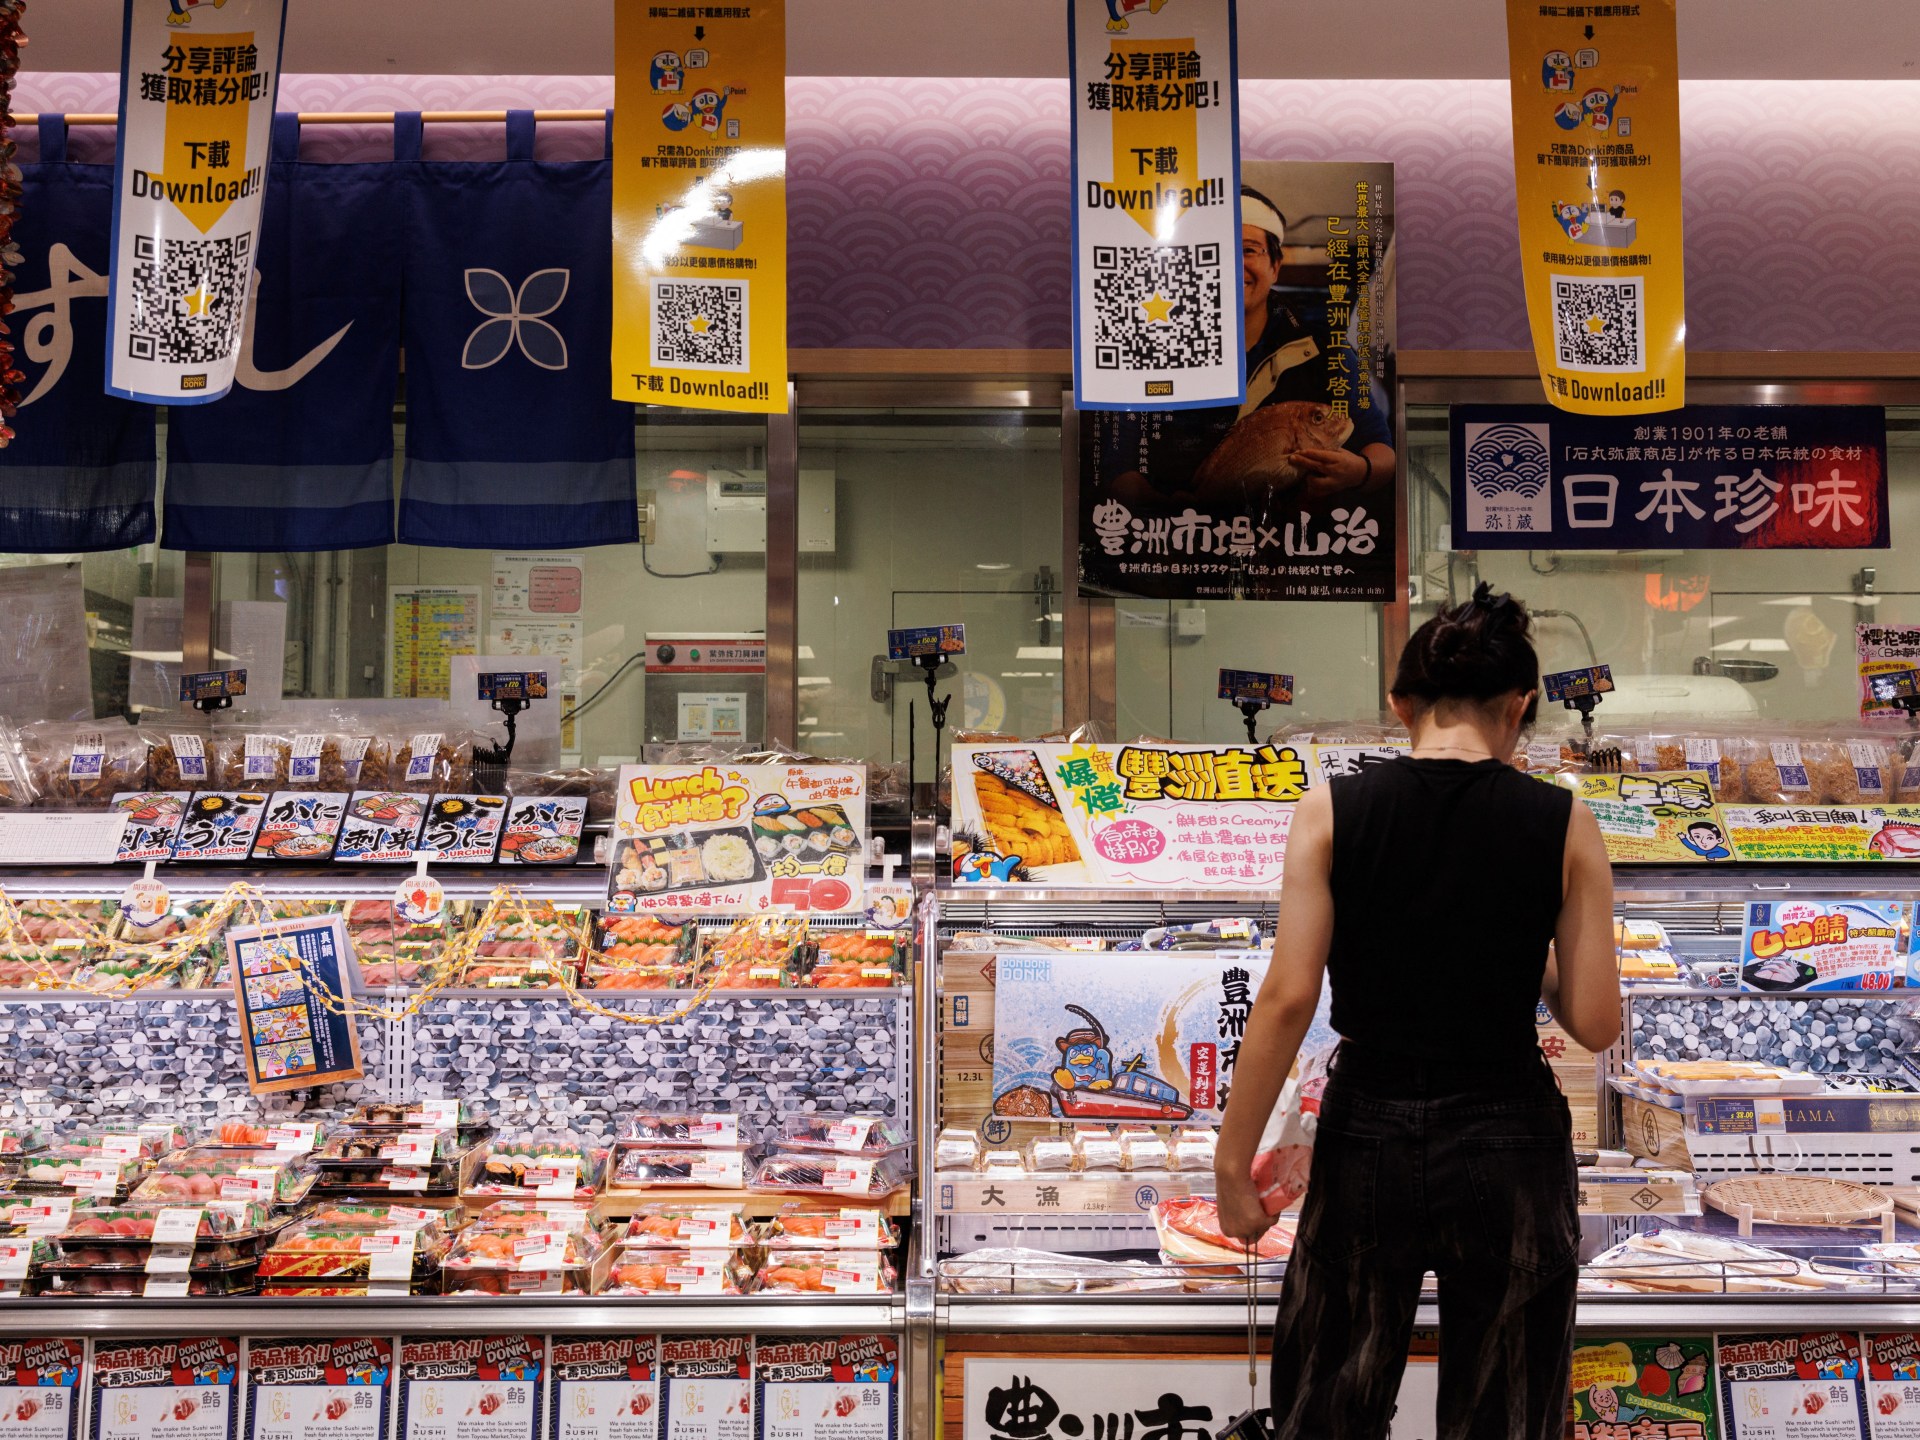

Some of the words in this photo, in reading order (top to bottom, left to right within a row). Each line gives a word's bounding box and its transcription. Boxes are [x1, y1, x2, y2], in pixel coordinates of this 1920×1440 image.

[162, 45, 258, 73] 分享評論
[1104, 52, 1201, 80] 分享評論
[140, 72, 268, 105] 獲取積分吧!
[1088, 81, 1220, 111] 獲取積分吧!
[184, 141, 230, 170] 下載
[1130, 147, 1178, 175] 下載
[133, 170, 261, 203] Download!!
[1087, 178, 1224, 210] Download!!
[1356, 181, 1370, 231] 世界最大
[631, 374, 665, 393] 下載
[669, 376, 770, 401] Download!!
[1547, 373, 1568, 397] 下載
[1571, 378, 1666, 402] Download!!
[1633, 426, 1789, 442] 創業1901年の老舗
[1564, 445, 1863, 463] 「石丸弥蔵商店」が作る日本伝統の食材
[1562, 467, 1866, 534] 日本珍味
[1093, 497, 1380, 557] 豊洲市場×山治
[1378, 746, 1401, 757] 45g
[629, 766, 725, 805] Lunch
[1116, 746, 1309, 802] 豐洲直送
[1618, 775, 1715, 810] 生蠔
[269, 800, 342, 823] かに
[511, 804, 585, 825] かに
[635, 786, 751, 833] 食咩好?
[1652, 806, 1711, 819] Oyster
[184, 820, 253, 849] うに
[265, 822, 300, 831] CRAB
[426, 822, 497, 851] うに
[508, 824, 541, 833] CRAB
[342, 827, 418, 853] 刺身
[119, 848, 171, 860] SASHIMI
[177, 849, 203, 858] SEA
[204, 846, 248, 856] URCHIN
[361, 850, 411, 861] SASHIMI
[450, 848, 492, 857] URCHIN
[1752, 914, 1849, 959] しめ鯖
[1542, 1036, 1566, 1059] 安
[957, 1073, 984, 1082] 12.3L
[1195, 1046, 1213, 1106] 空運到港
[987, 1119, 1006, 1136] 鮮
[1645, 1117, 1657, 1147] 魚
[982, 1186, 1060, 1207] 大漁
[1140, 1188, 1156, 1206] 魚
[1640, 1193, 1653, 1205] 旬
[178, 1347, 198, 1357] DON
[200, 1337, 219, 1348] DON
[332, 1347, 351, 1356] DON
[353, 1338, 373, 1348] DON
[401, 1340, 483, 1363] 商品推介!!
[484, 1342, 504, 1352] DON
[506, 1334, 525, 1345] DON
[486, 1341, 531, 1364] DONKI
[553, 1339, 633, 1364] 商品推介!!
[634, 1340, 654, 1351] DON
[661, 1338, 742, 1361] 商品推介!!
[838, 1343, 858, 1353] DON
[859, 1335, 879, 1346] DON
[1719, 1340, 1798, 1364] 商品推介!!
[1800, 1341, 1818, 1351] DON
[1820, 1333, 1839, 1344] DON
[1803, 1339, 1846, 1363] DONKI
[95, 1345, 177, 1370] 商品推介!!
[180, 1345, 225, 1369] DONKI
[249, 1345, 330, 1368] 商品推介!!
[334, 1345, 379, 1368] DONKI
[756, 1342, 837, 1366] 商品推介!!
[840, 1343, 885, 1366] DONKI
